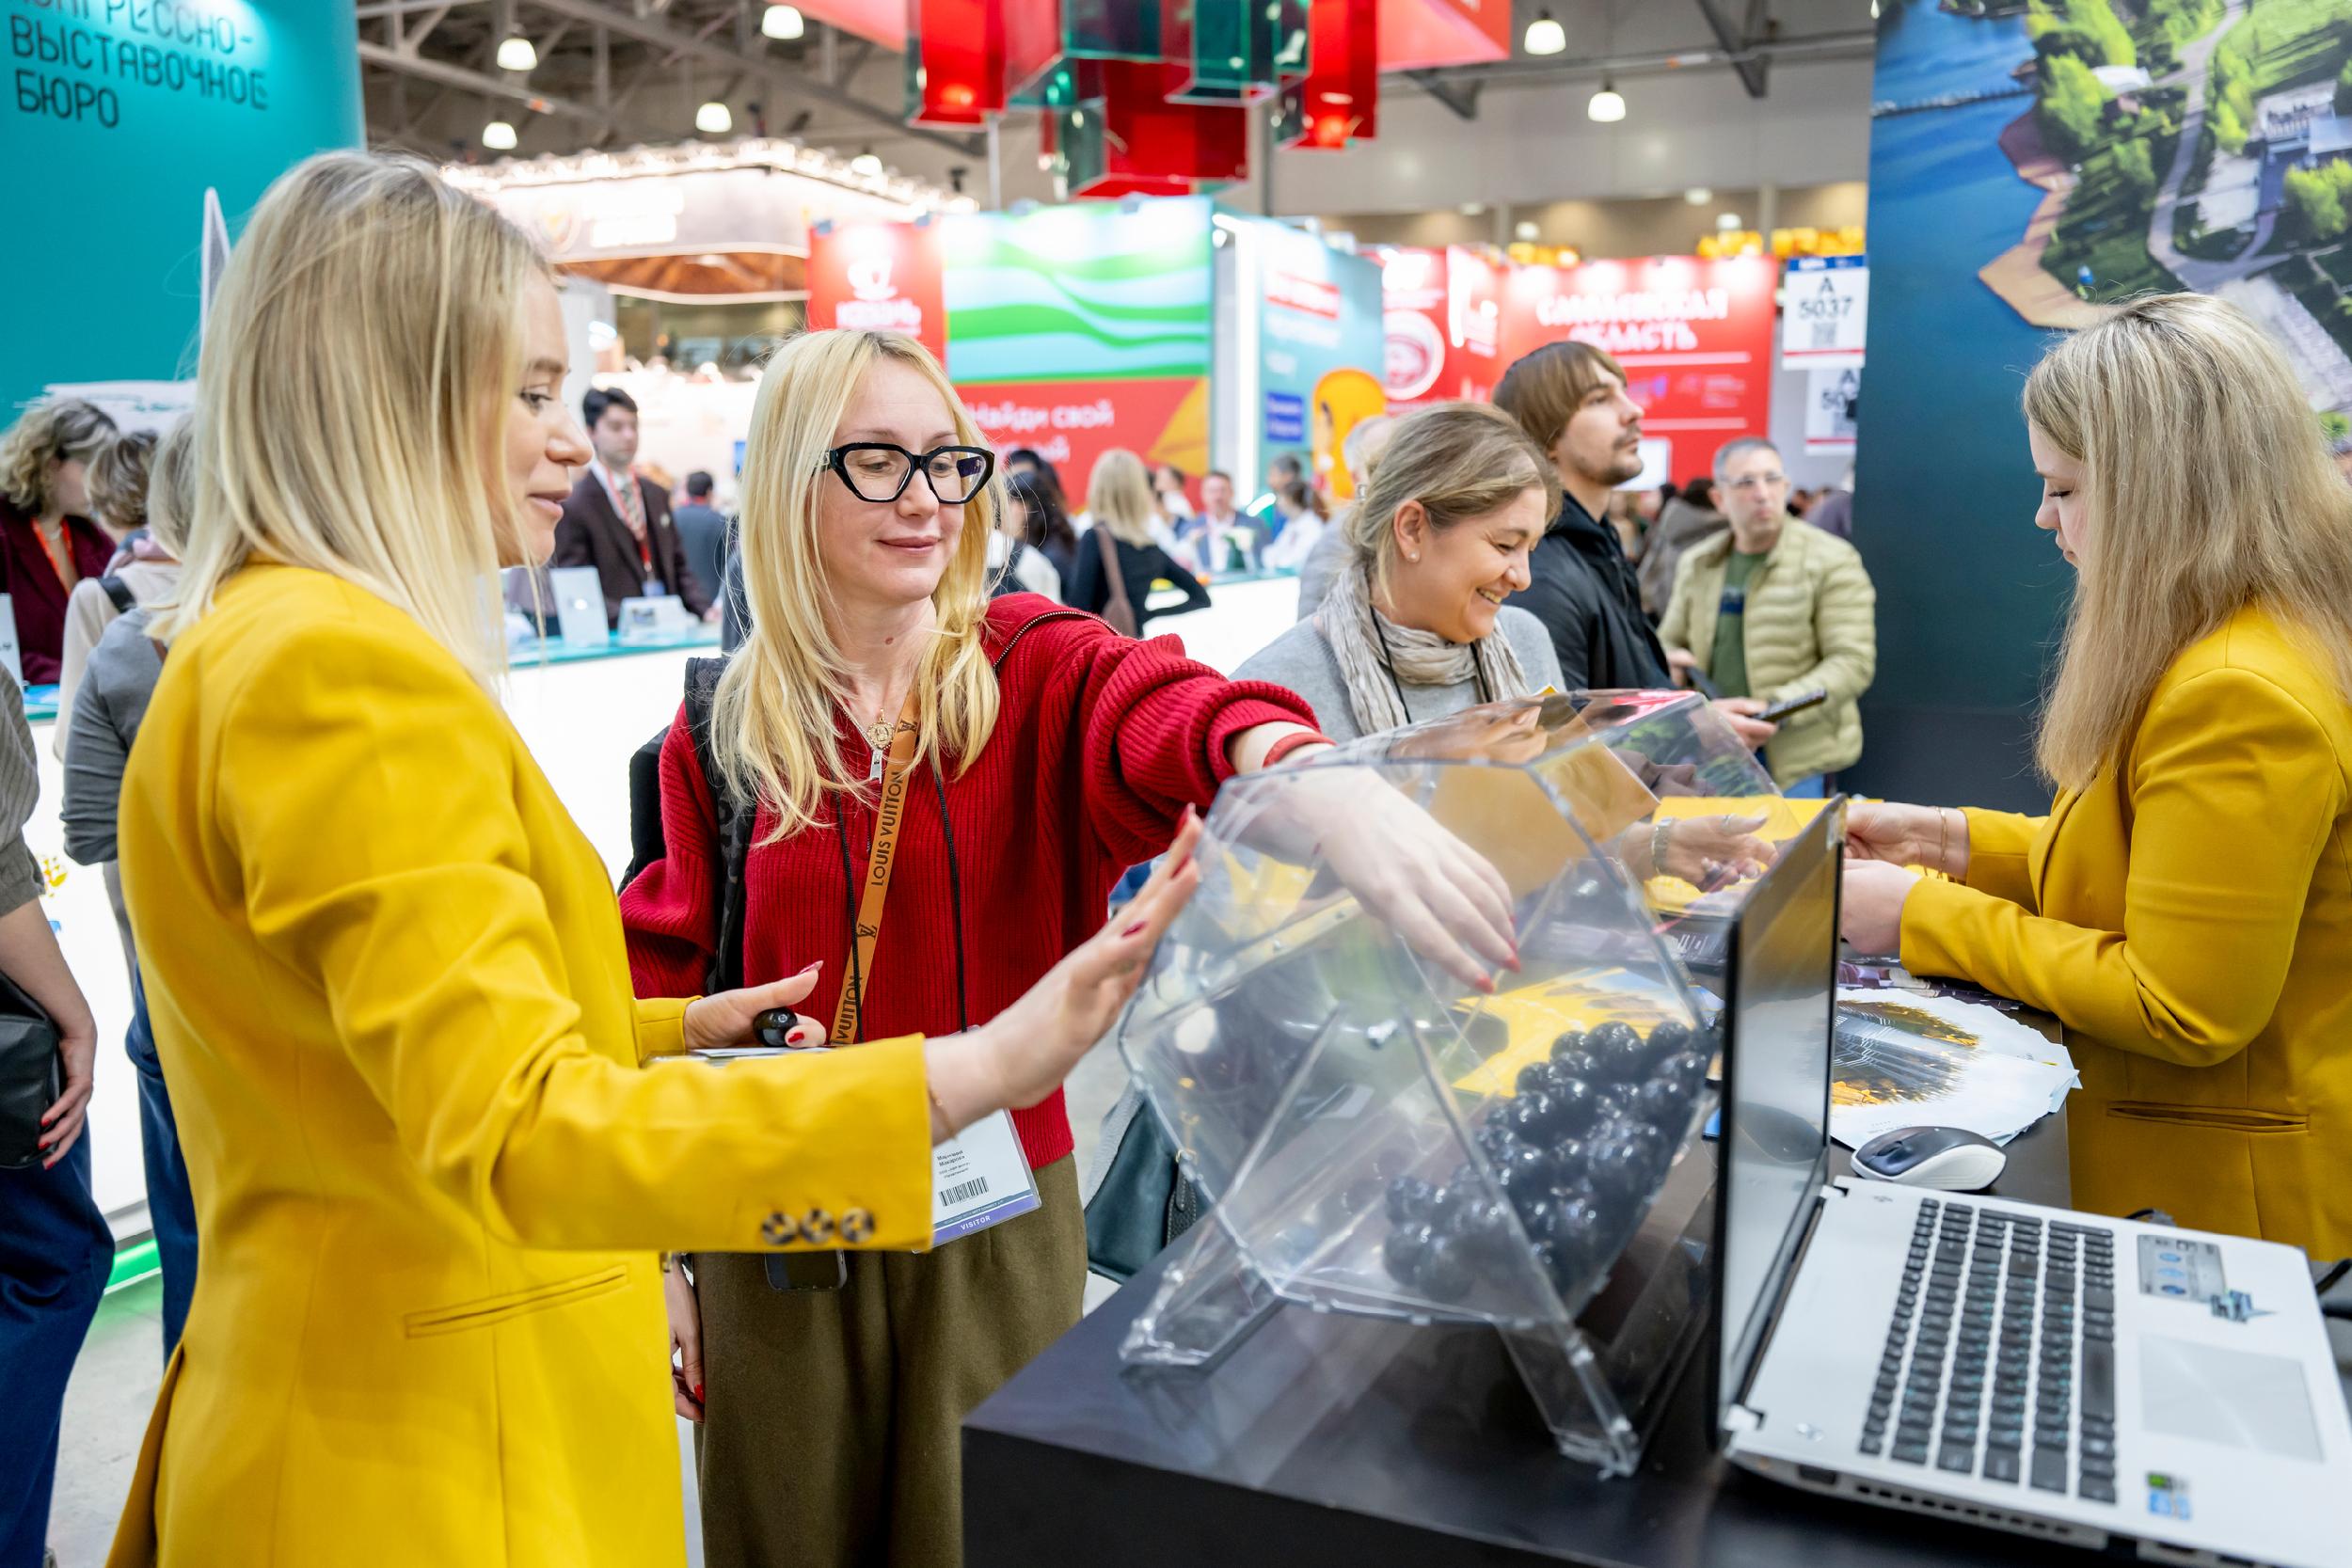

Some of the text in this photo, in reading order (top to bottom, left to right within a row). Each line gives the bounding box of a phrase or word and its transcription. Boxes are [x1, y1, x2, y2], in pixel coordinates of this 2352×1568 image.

[10, 14, 269, 111] ВЫСТАВОЧНОЕ
[15, 68, 119, 129] БЮРО
[1800, 297, 1852, 318] 5037
[871, 771, 904, 886] LOUIS VUITTON
[961, 1215, 991, 1229] VISITOR
